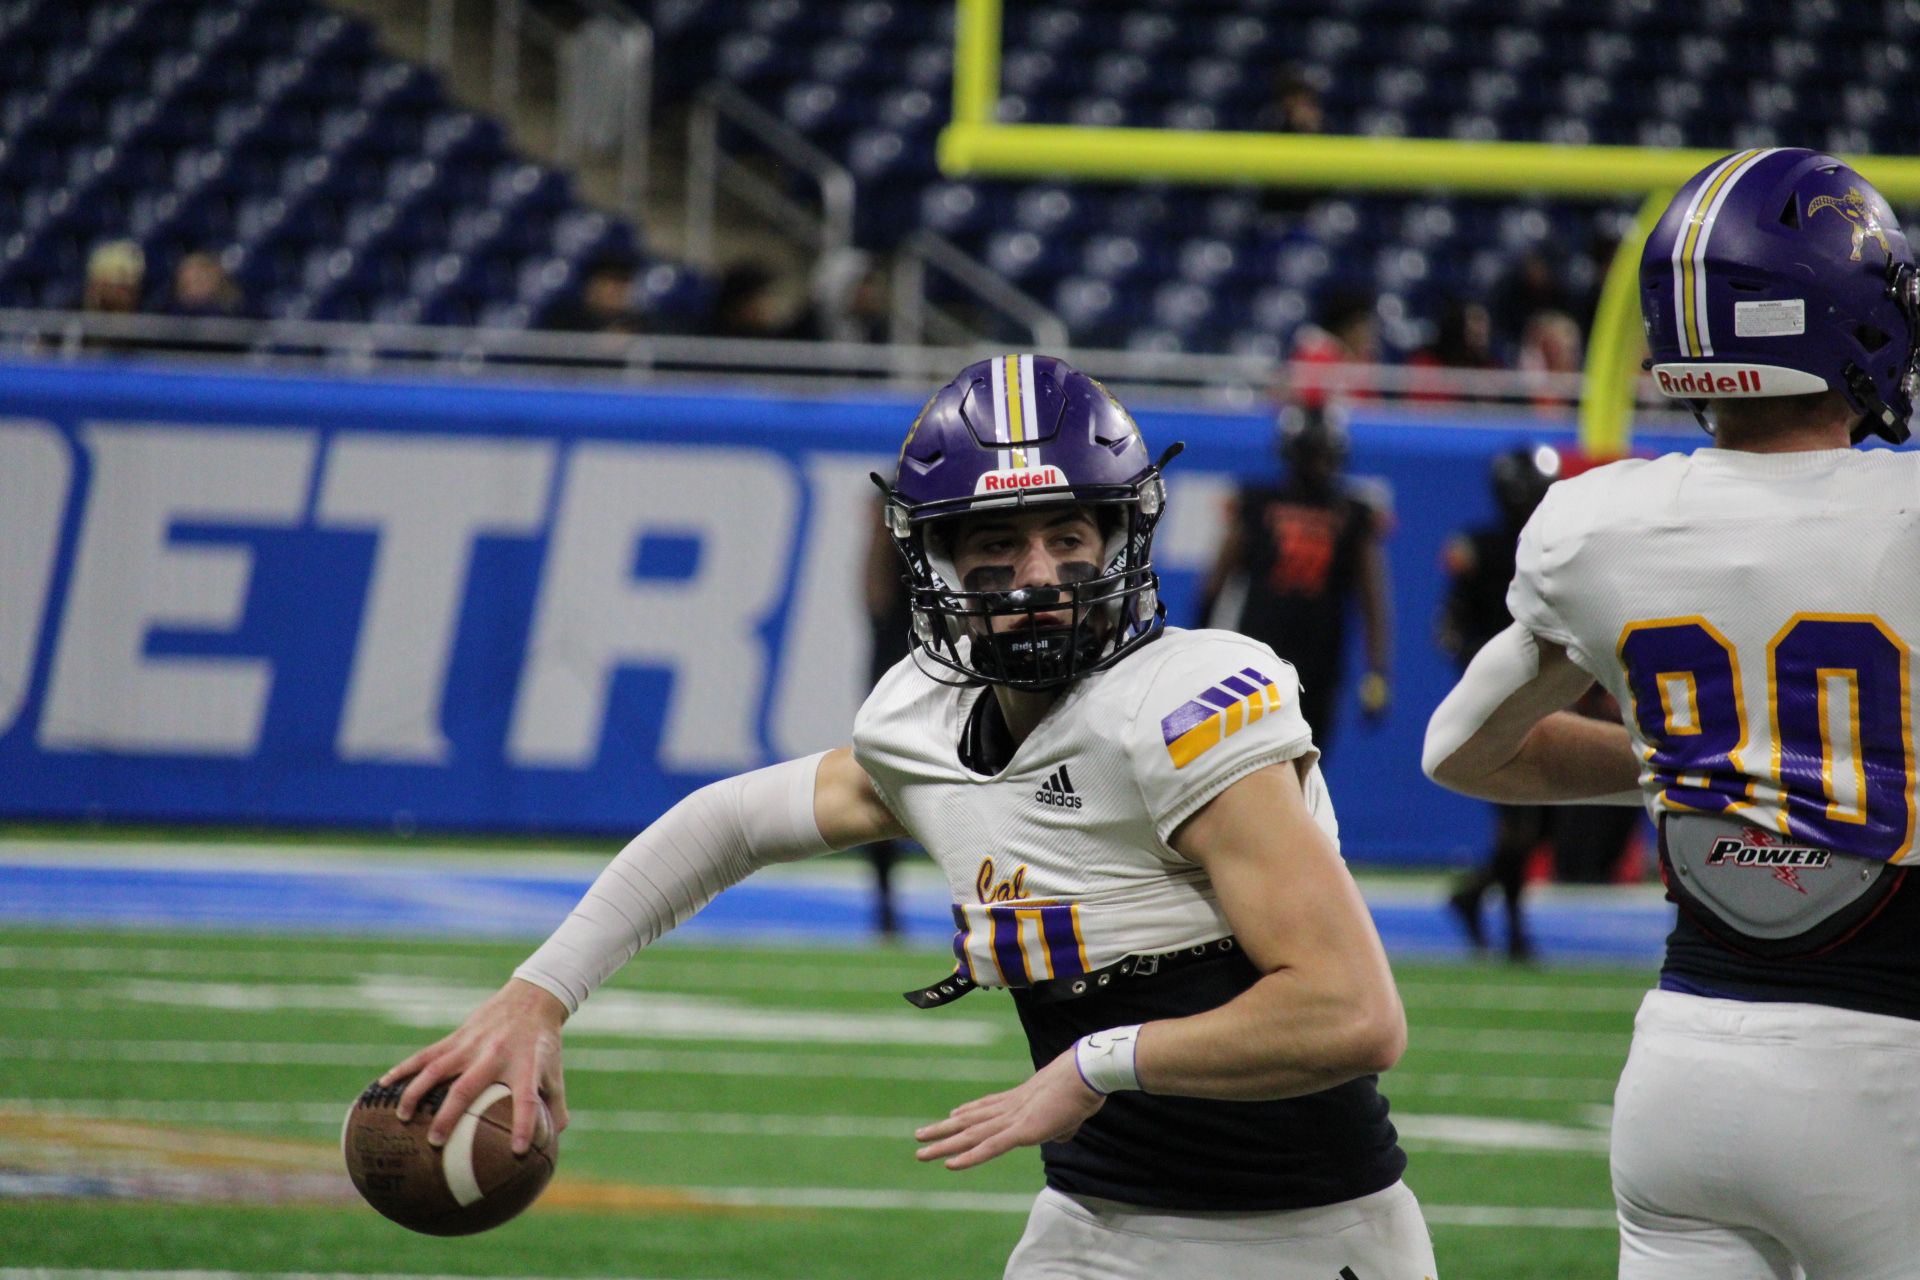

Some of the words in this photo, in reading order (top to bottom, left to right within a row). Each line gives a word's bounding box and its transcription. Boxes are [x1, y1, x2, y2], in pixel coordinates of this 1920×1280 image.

[1657, 370, 1761, 393] Riddell
[984, 469, 1057, 491] Riddell
[1616, 611, 1917, 864] 80
[1035, 789, 1082, 809] adidas
[1707, 838, 1831, 867] POWER
[976, 857, 1031, 905] Cal
